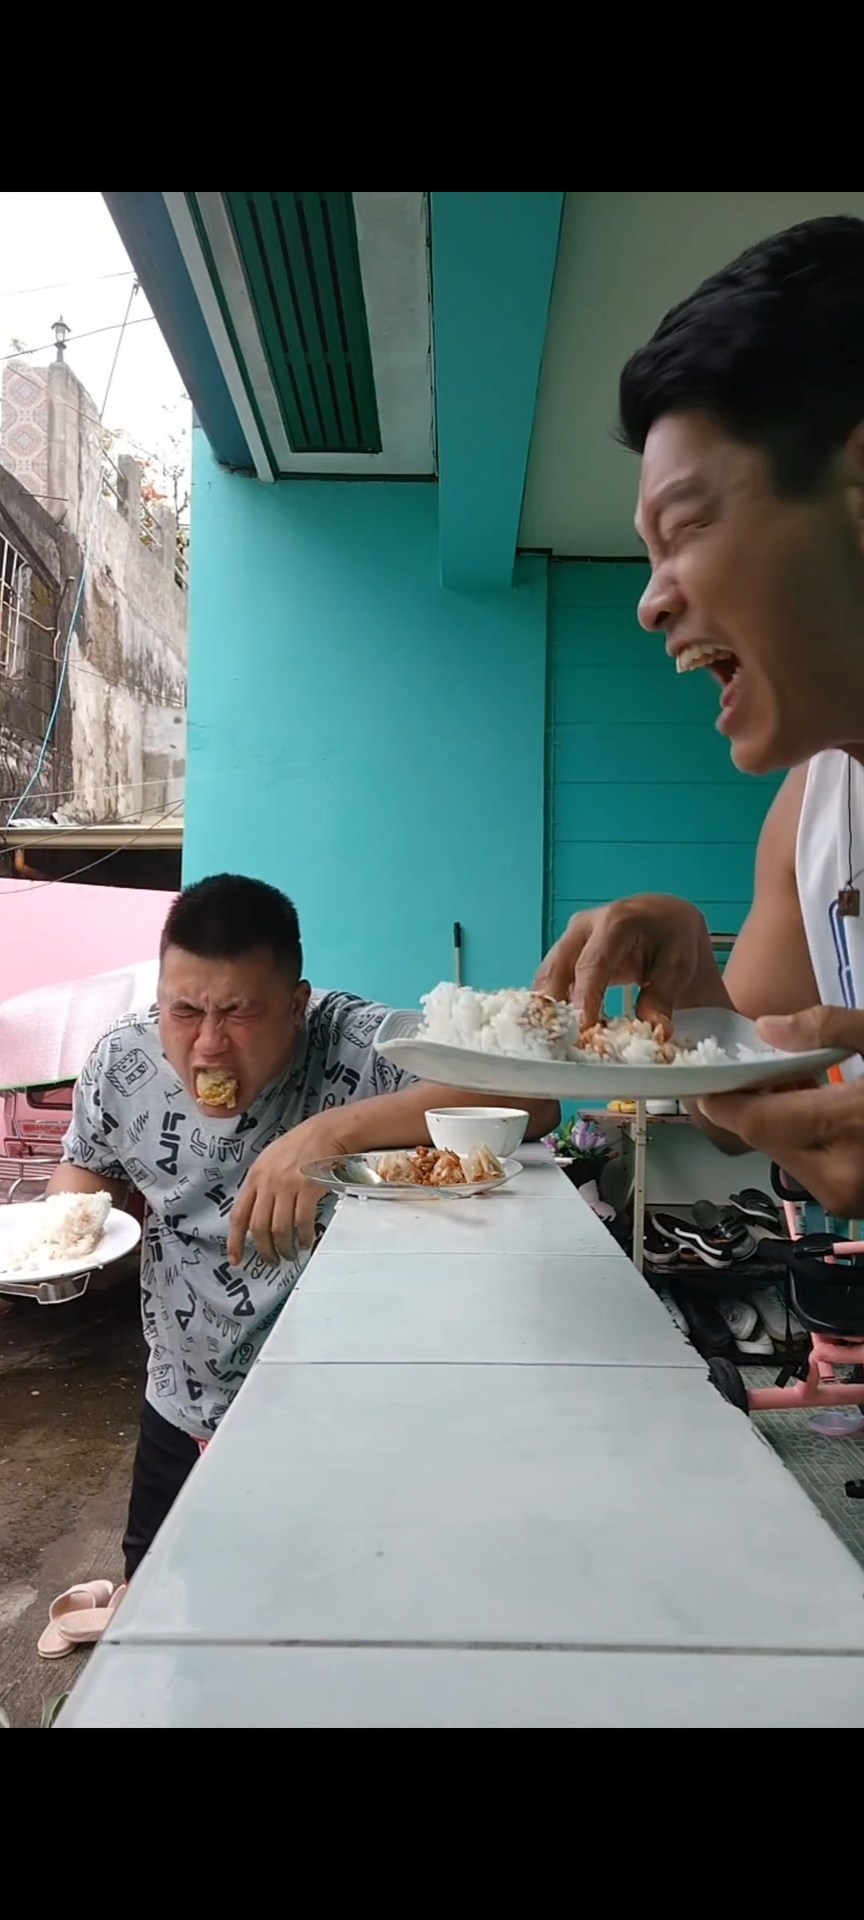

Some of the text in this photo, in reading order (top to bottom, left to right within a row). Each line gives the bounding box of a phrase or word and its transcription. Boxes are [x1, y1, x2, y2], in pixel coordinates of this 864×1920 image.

[155, 1110, 187, 1176] FILA
[189, 1127, 245, 1164] FILA
[212, 1261, 256, 1317] FILA
